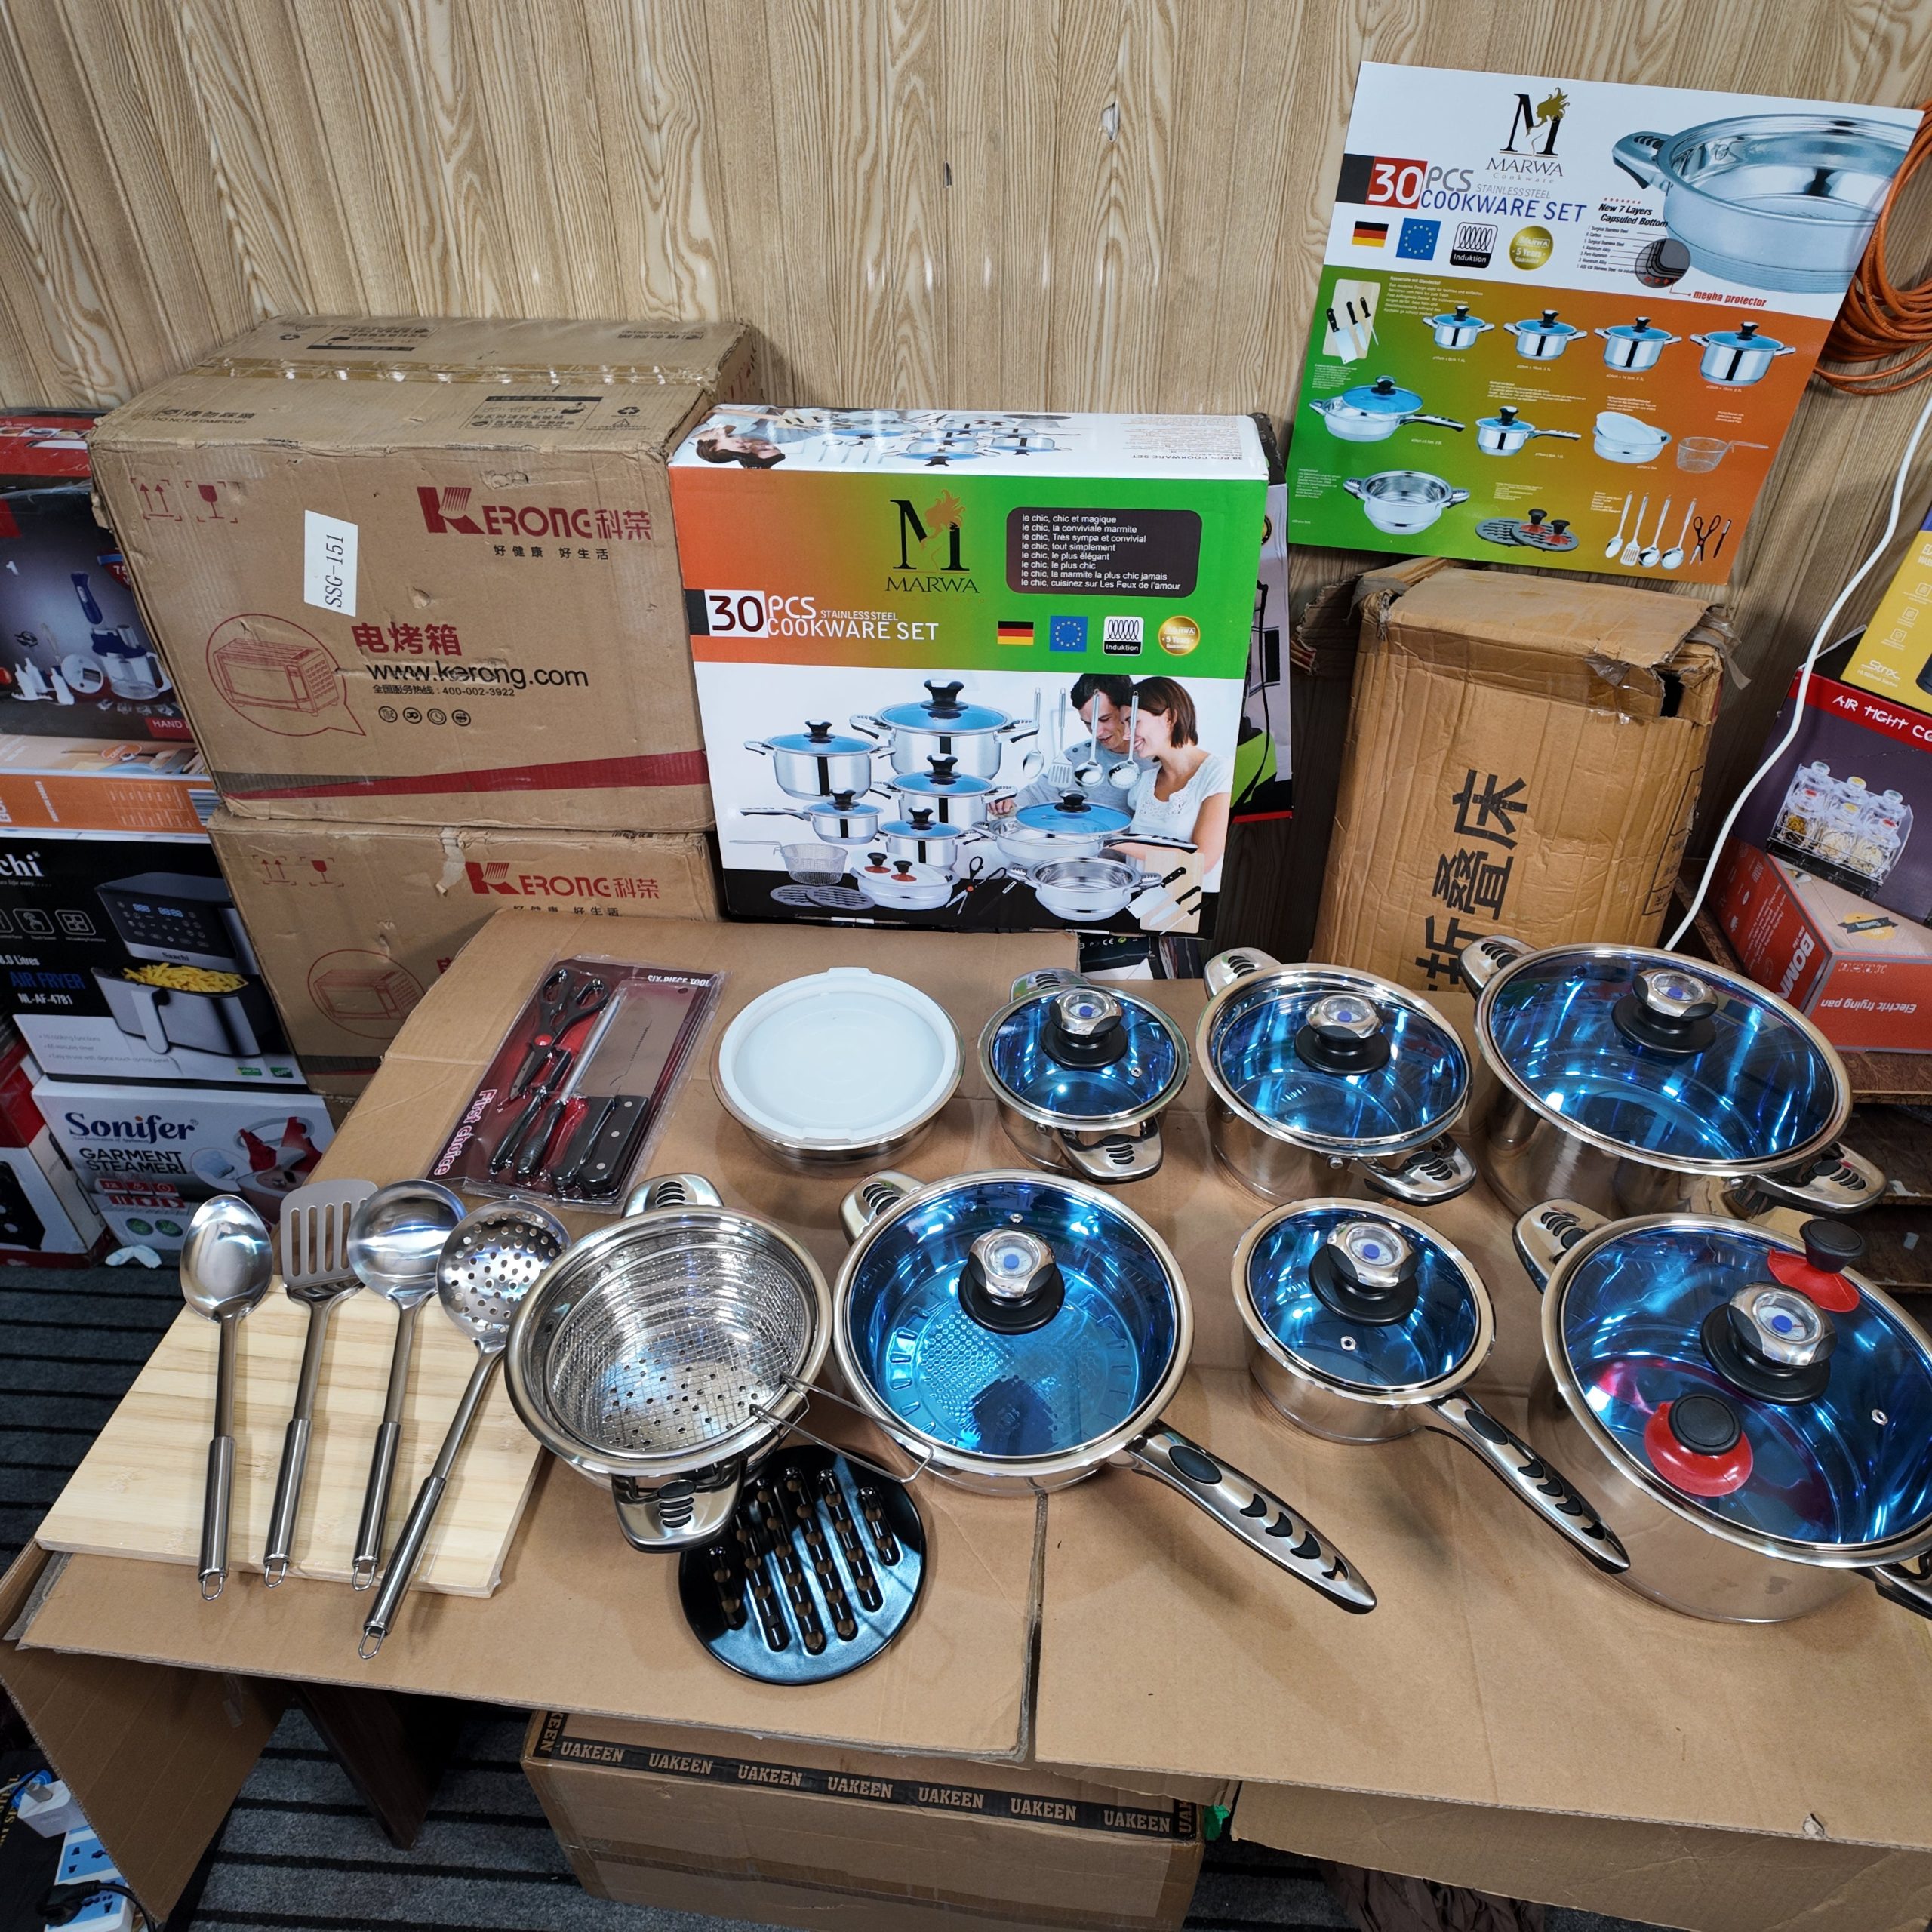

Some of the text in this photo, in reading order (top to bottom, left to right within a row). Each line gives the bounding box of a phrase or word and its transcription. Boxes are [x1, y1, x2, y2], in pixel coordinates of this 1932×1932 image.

[1485, 158, 1563, 177] MARWA
[1368, 163, 1474, 205] 30 PCS
[1421, 189, 1587, 223] COOKWARE SET
[1598, 203, 1617, 213] New
[1626, 205, 1653, 216] Layers
[1600, 214, 1669, 228] Capsuled Bottom
[1453, 253, 1487, 263] Induktion
[1516, 248, 1542, 258] 5 Years
[1693, 291, 1767, 308] megha protector
[594, 509, 652, 540] 科荣
[1032, 515, 1051, 525] chic,
[1081, 515, 1117, 525] magique
[1032, 524, 1051, 534] chic,
[1032, 533, 1050, 543] chic,
[1072, 535, 1099, 544] sympa
[494, 544, 609, 561] 好健康 好生活
[1032, 543, 1050, 552] chic,
[1069, 543, 1115, 553] simplement
[1031, 552, 1050, 561] chic,
[1061, 552, 1077, 562] plus
[1080, 552, 1109, 563] élégant
[325, 534, 344, 608] SSG-151
[1031, 561, 1050, 571] chic,
[1061, 561, 1077, 570] plus
[1031, 570, 1049, 580] chic,
[1104, 571, 1121, 581] plus
[1141, 572, 1168, 582] jamais
[884, 577, 980, 594] MARWA
[1031, 579, 1049, 587] chic,
[1138, 580, 1149, 589] de
[709, 595, 817, 632] 30 PCS
[768, 617, 939, 640] COOKWARE SET
[351, 622, 462, 656] 电烤箱
[1106, 643, 1139, 651] Induktion
[366, 661, 589, 689] www.kerong.com
[442, 686, 515, 697] 400-002-3922
[1832, 695, 1859, 712] AIR
[1864, 706, 1909, 730] TIGHT
[152, 720, 183, 728] HAND
[614, 878, 660, 899] 科荣
[14, 955, 40, 966] Litres
[9, 971, 85, 990] AIR FRYER
[690, 977, 712, 987] TOOL
[17, 993, 73, 1005] NL-AF-4781
[1820, 998, 1917, 1014] Electric frying pan
[463, 1089, 497, 1124] First
[65, 1112, 195, 1144] Sonifer
[85, 1160, 180, 1174] STEAMER
[561, 1742, 1171, 1833] UAKEEN UAKEEN UAKEEN UAKEEN UAKEEN UAKEEN UAKEEN
